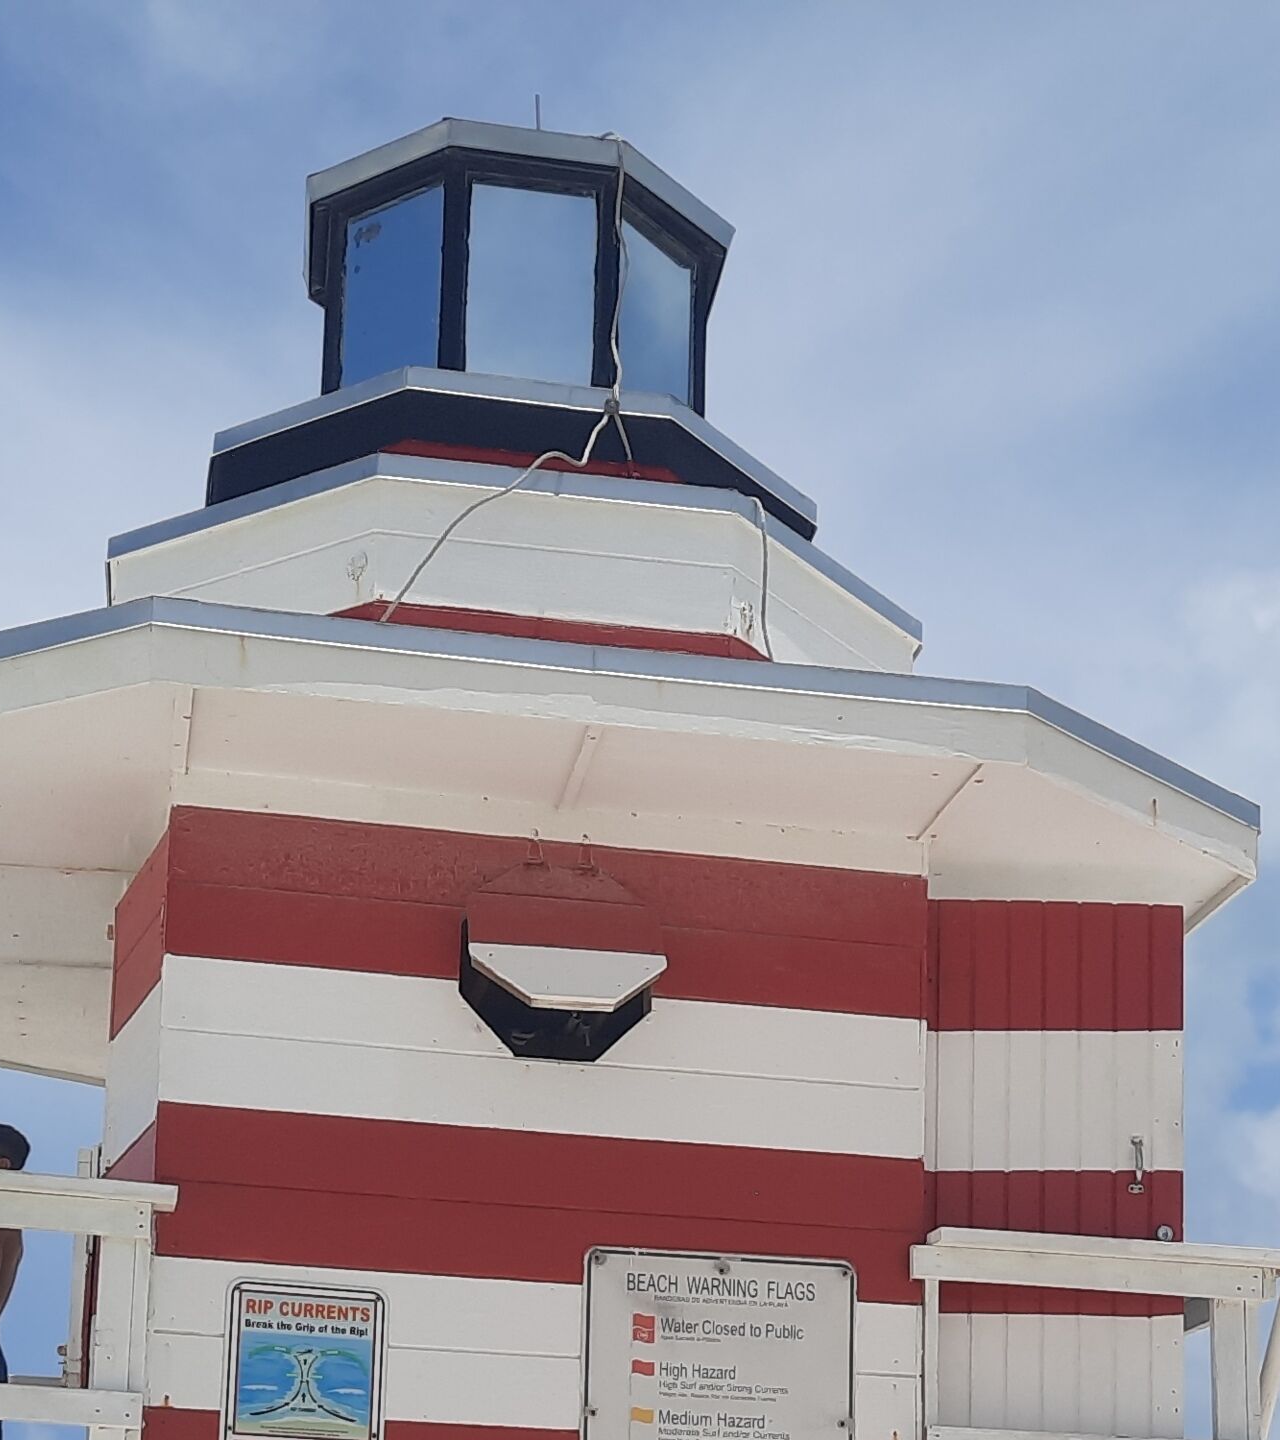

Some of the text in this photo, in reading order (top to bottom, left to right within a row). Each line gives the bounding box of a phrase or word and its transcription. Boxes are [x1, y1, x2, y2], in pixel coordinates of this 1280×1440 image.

[626, 1272, 816, 1301] BEACH WARNING FLAGS
[245, 1299, 370, 1322] RIP CURRENTS
[245, 1319, 368, 1337] Break the Grip of the Rip!
[660, 1318, 804, 1340] Water Closed to Public
[659, 1362, 737, 1380] High Hazard
[658, 1409, 765, 1429] Medium Hazard
